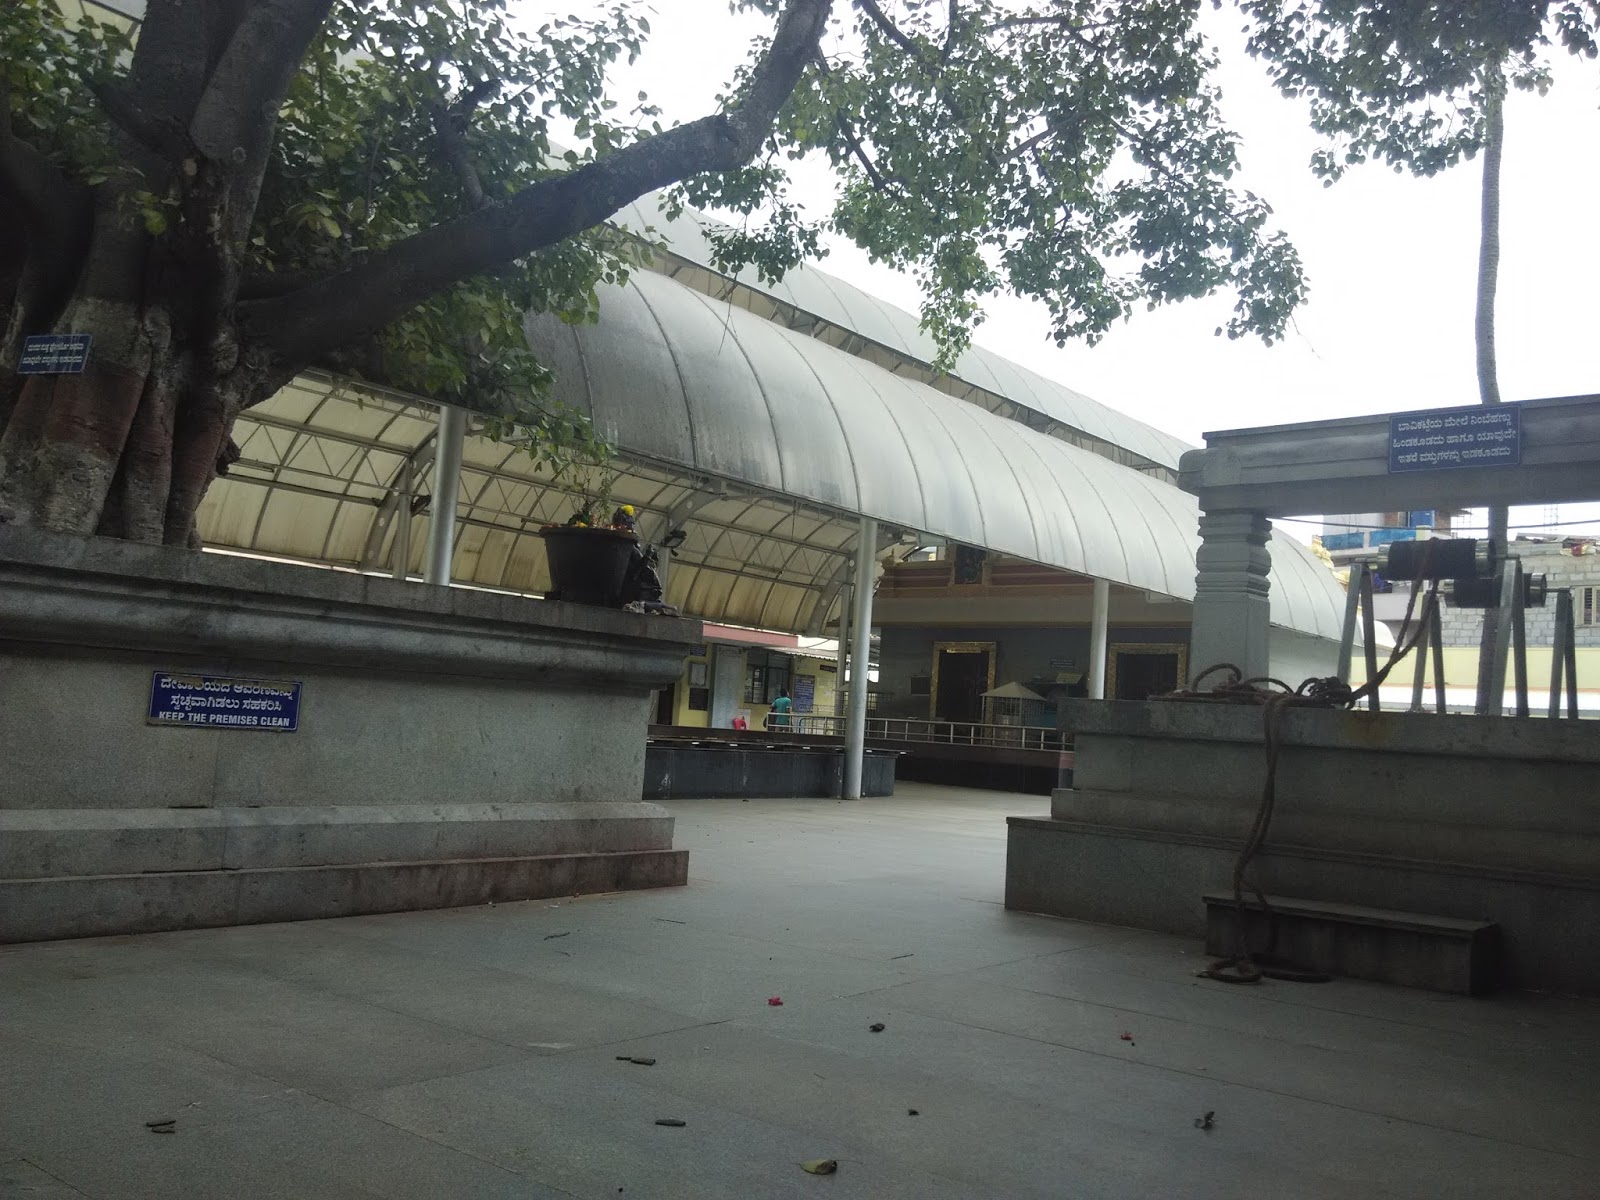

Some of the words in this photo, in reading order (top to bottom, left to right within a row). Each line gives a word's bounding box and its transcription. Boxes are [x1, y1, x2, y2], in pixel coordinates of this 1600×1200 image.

[1444, 415, 1469, 427] ಮೇಲೆ
[1470, 412, 1512, 426] ನಿಂಬೆಹಣ್ಣು
[1392, 434, 1444, 448] ಹಿಂಡಕೂಡದು
[1446, 432, 1475, 443] ಹಾಗೂ
[1476, 428, 1516, 442] ಯಾವುದೇ
[1397, 452, 1418, 464] ಇತರೆ
[1419, 450, 1461, 464] ವಸ್ತುಗಳನ್ನು
[1461, 446, 1511, 459] ಇಡಕೂಡದು
[242, 697, 282, 711] ಸಹಕರಿಸಿ
[159, 711, 185, 720] KEEP
[187, 712, 207, 722] THE
[209, 713, 258, 726] PREMISES
[260, 715, 290, 727] CLEAN
